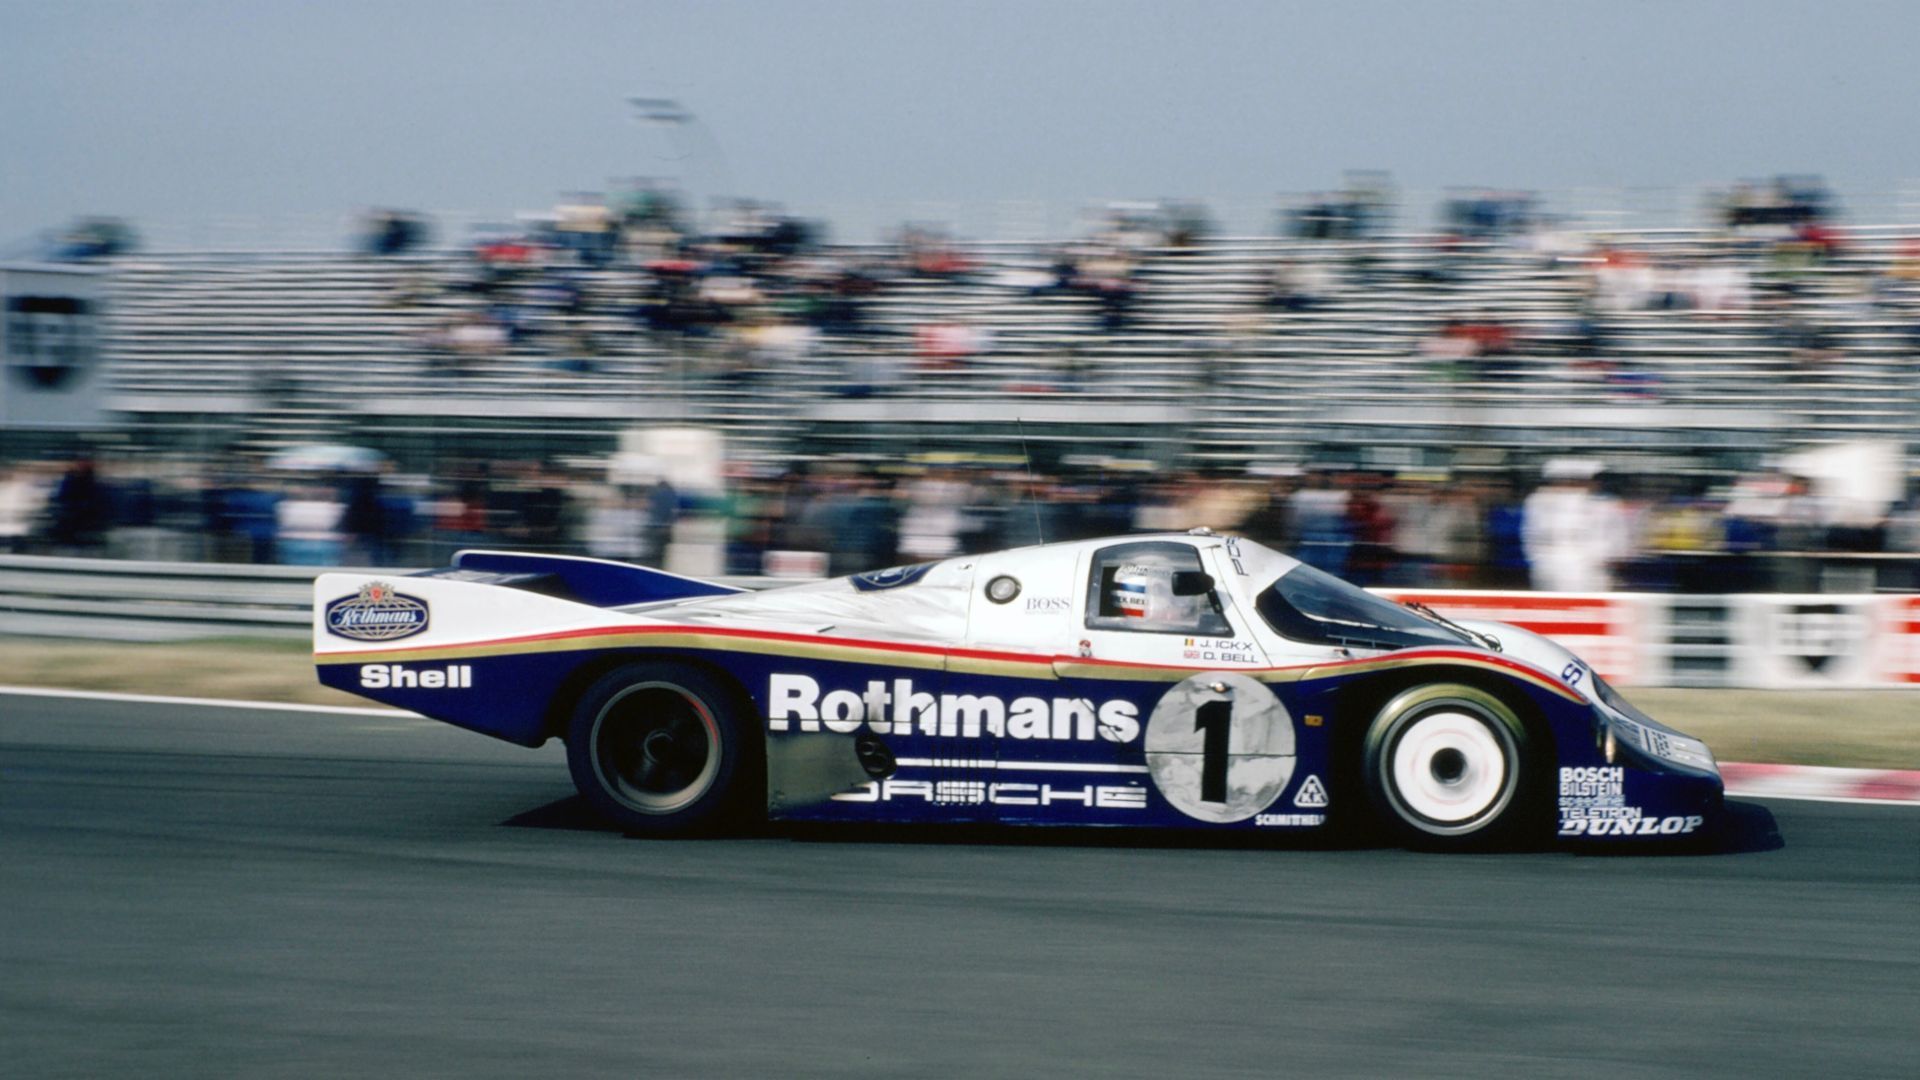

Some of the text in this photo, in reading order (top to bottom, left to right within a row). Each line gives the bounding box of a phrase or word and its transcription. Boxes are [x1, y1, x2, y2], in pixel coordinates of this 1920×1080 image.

[1026, 597, 1071, 610] BOSS
[335, 606, 417, 627] Rothmans
[1200, 640, 1253, 651] J. ICKX
[1203, 651, 1259, 663] D. BELL
[360, 664, 472, 689] Shell
[769, 672, 1141, 743] Rothmans
[1194, 700, 1233, 804] 1
[1559, 767, 1624, 782] BOSCH
[830, 777, 1148, 808] ORSCHE
[1559, 782, 1623, 796] BILSTEIN
[1559, 807, 1642, 819] TELETRON
[1558, 816, 1704, 836] DUNLOP
